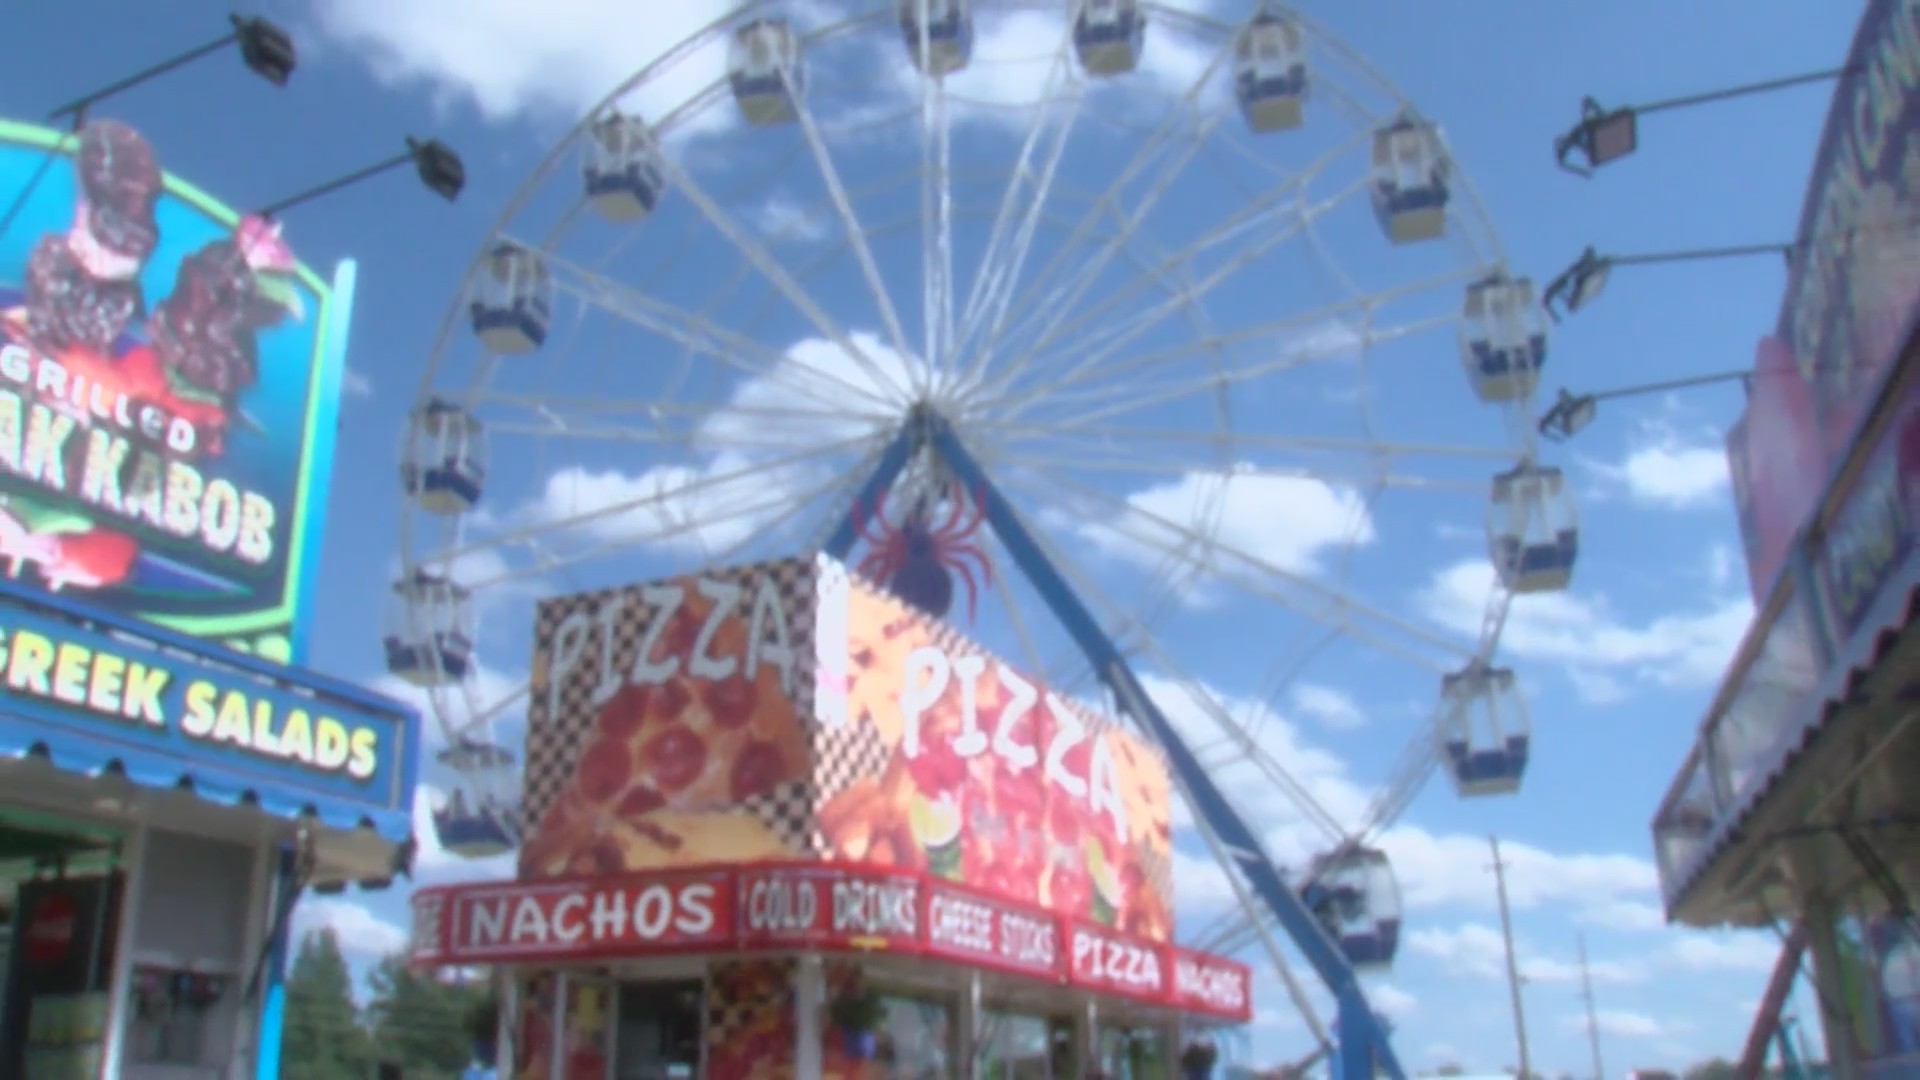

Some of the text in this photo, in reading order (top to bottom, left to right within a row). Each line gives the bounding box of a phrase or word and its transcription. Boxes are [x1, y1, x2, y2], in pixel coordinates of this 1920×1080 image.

[81, 426, 274, 564] KABOB
[548, 573, 796, 722] PIZZA
[0, 624, 378, 779] REEK SALADS
[901, 646, 1128, 844] PIZZA
[469, 883, 716, 943] NACHOS
[750, 878, 917, 936] COLD DRINKS
[1072, 930, 1161, 992] PIZZA
[1174, 956, 1245, 1010] NACHOS
